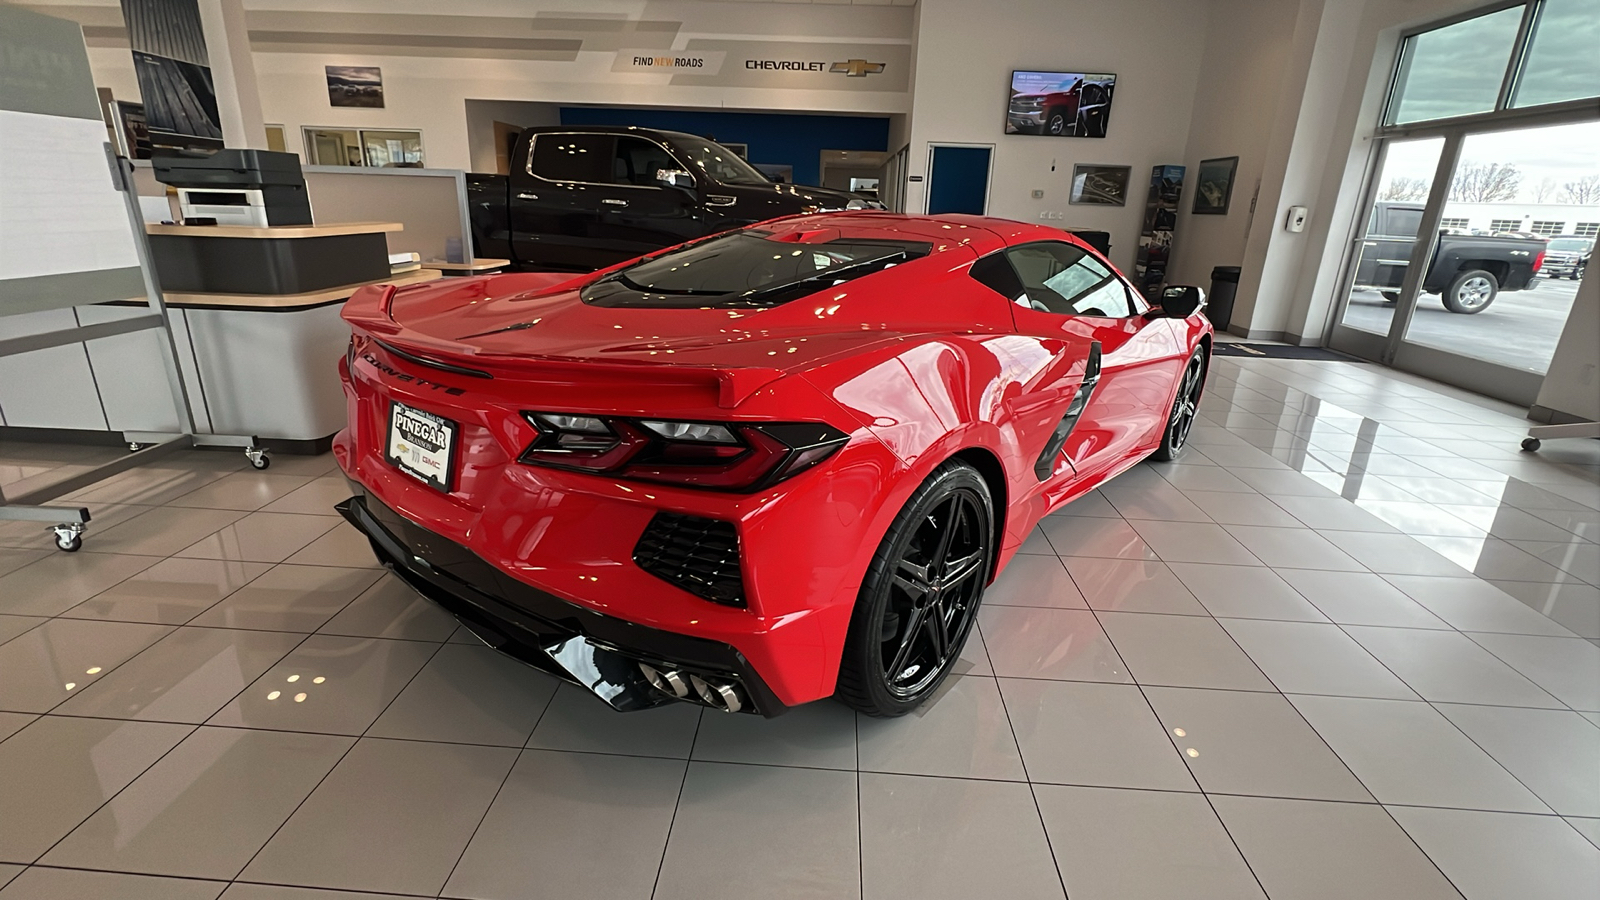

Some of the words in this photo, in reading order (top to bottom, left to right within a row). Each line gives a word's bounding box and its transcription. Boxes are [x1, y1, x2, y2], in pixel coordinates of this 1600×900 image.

[633, 57, 653, 66] FIND
[653, 57, 674, 67] NEW
[674, 58, 704, 68] ROADS
[745, 60, 826, 72] CHEVROLET
[363, 354, 466, 396] CORVETTE
[396, 413, 446, 448] PINEGAR
[422, 456, 441, 469] GMC
